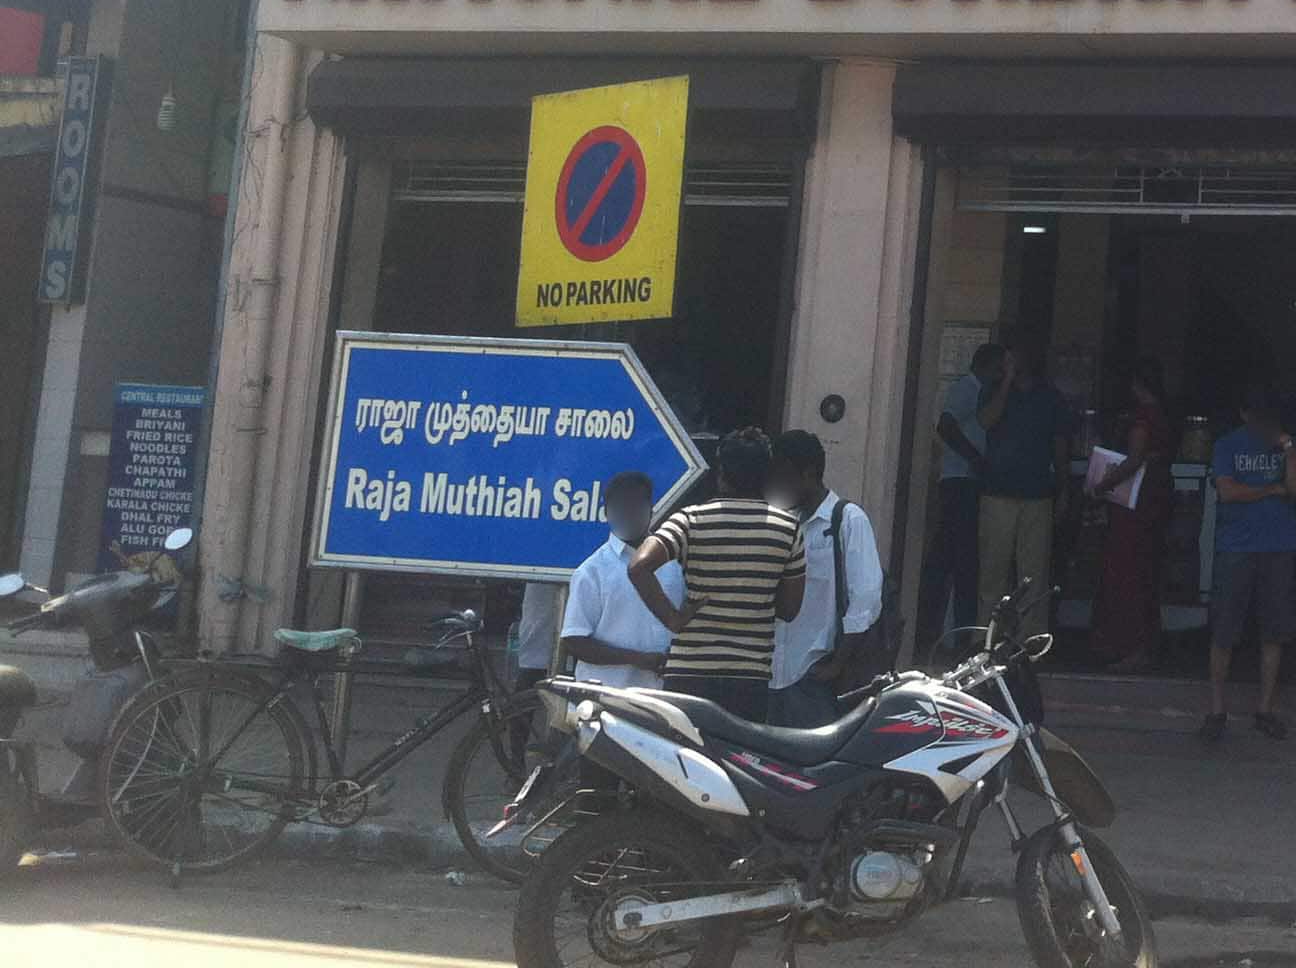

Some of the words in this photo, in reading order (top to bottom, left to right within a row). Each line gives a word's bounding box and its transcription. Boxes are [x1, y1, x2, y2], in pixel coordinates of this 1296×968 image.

[46, 73, 89, 299] ROOMS
[536, 282, 563, 308] NO
[565, 276, 652, 306] PARKING
[141, 407, 182, 419] MEALS
[135, 419, 185, 431] BRIYANI
[356, 397, 421, 445] ராஜா
[555, 407, 635, 440] சாலை
[126, 431, 161, 442] FRIED
[164, 433, 193, 444] RICE
[129, 442, 187, 454] NOODLES
[132, 453, 181, 466] PAROTA
[125, 464, 187, 478] CHAPATHI
[133, 477, 176, 489] APPAM
[345, 468, 410, 521] Raja
[420, 473, 543, 519] Muthiah
[550, 478, 608, 523] Sal
[107, 499, 148, 511] KARALA
[121, 512, 152, 523] DHAL
[157, 514, 181, 525] FRY
[120, 523, 145, 535] ALU
[121, 535, 148, 546] FISH
